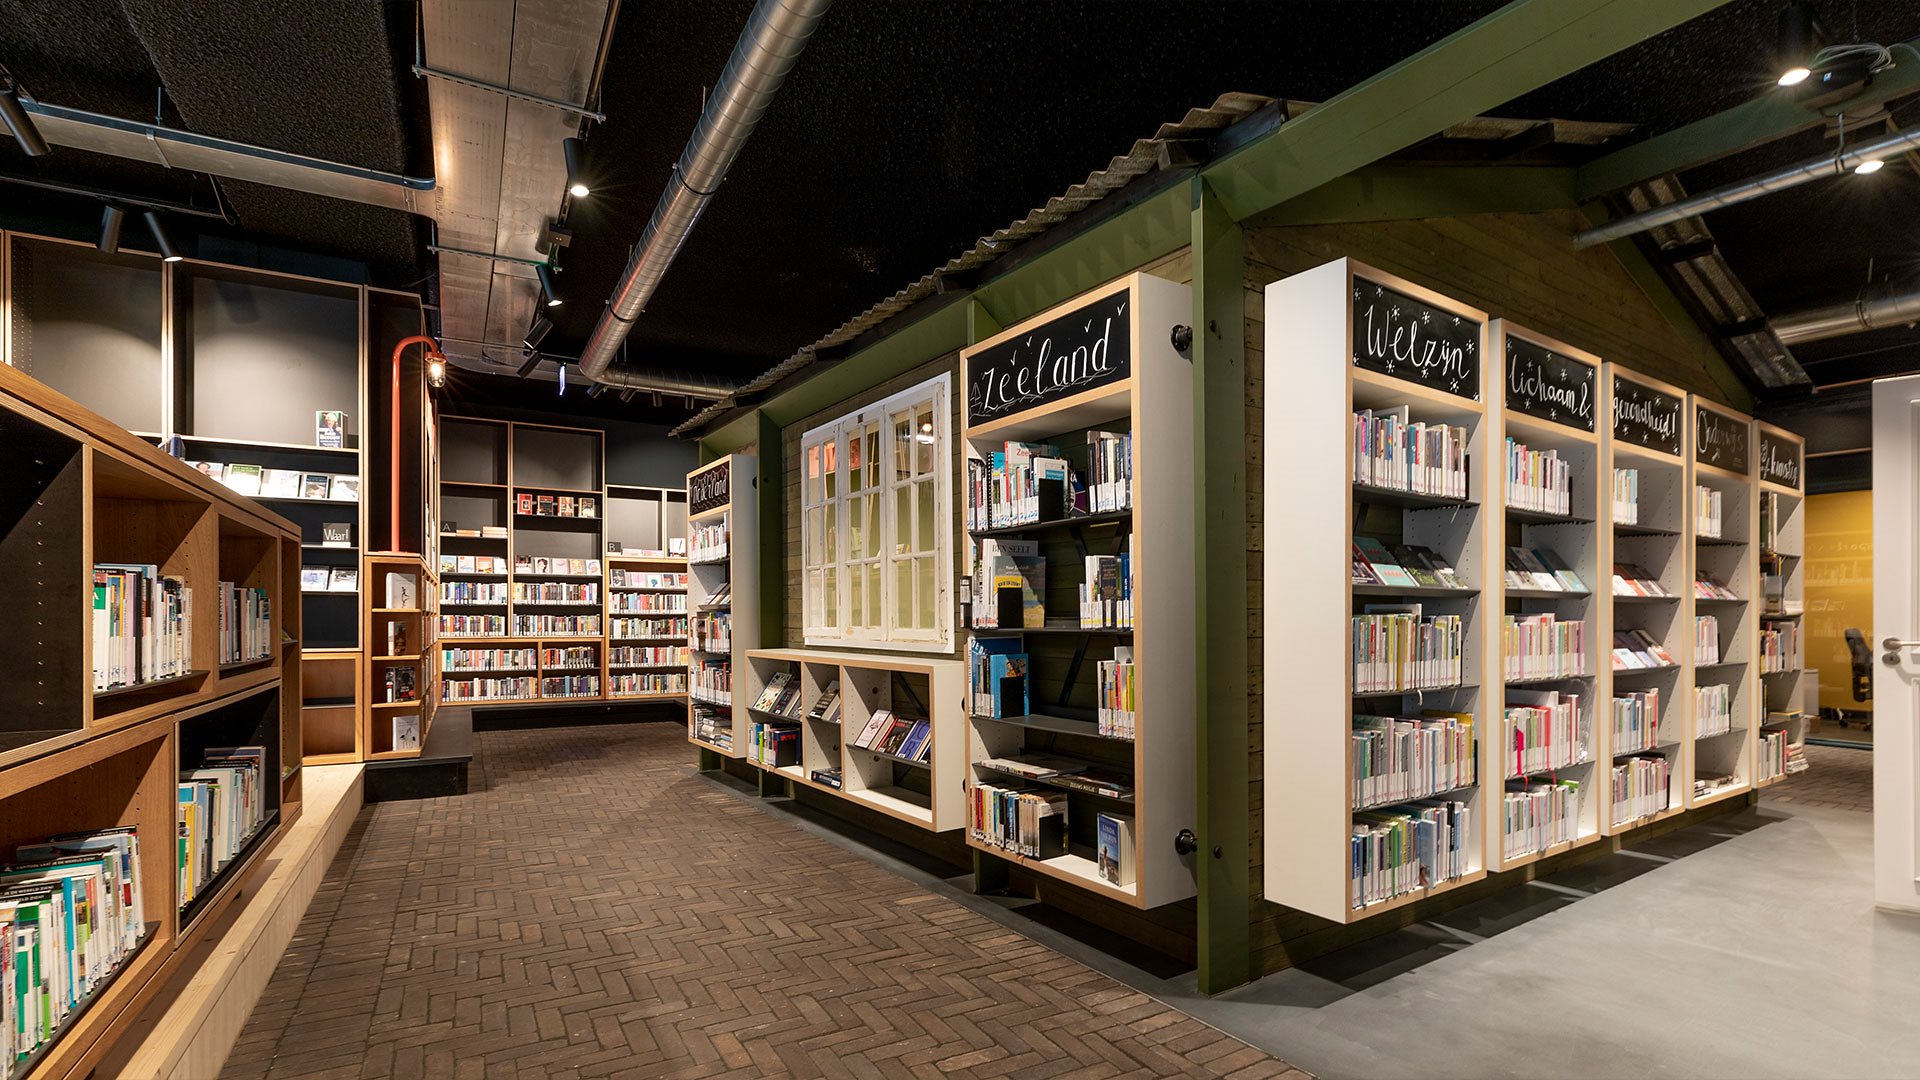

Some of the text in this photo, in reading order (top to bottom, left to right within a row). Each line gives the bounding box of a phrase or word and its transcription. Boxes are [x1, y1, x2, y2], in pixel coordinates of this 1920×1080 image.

[1364, 304, 1470, 379] Welzijn
[983, 317, 1112, 411] Zeeland
[1579, 381, 1592, 419] &
[323, 528, 349, 541] Waar!
[442, 522, 451, 532] A
[608, 542, 616, 552] B
